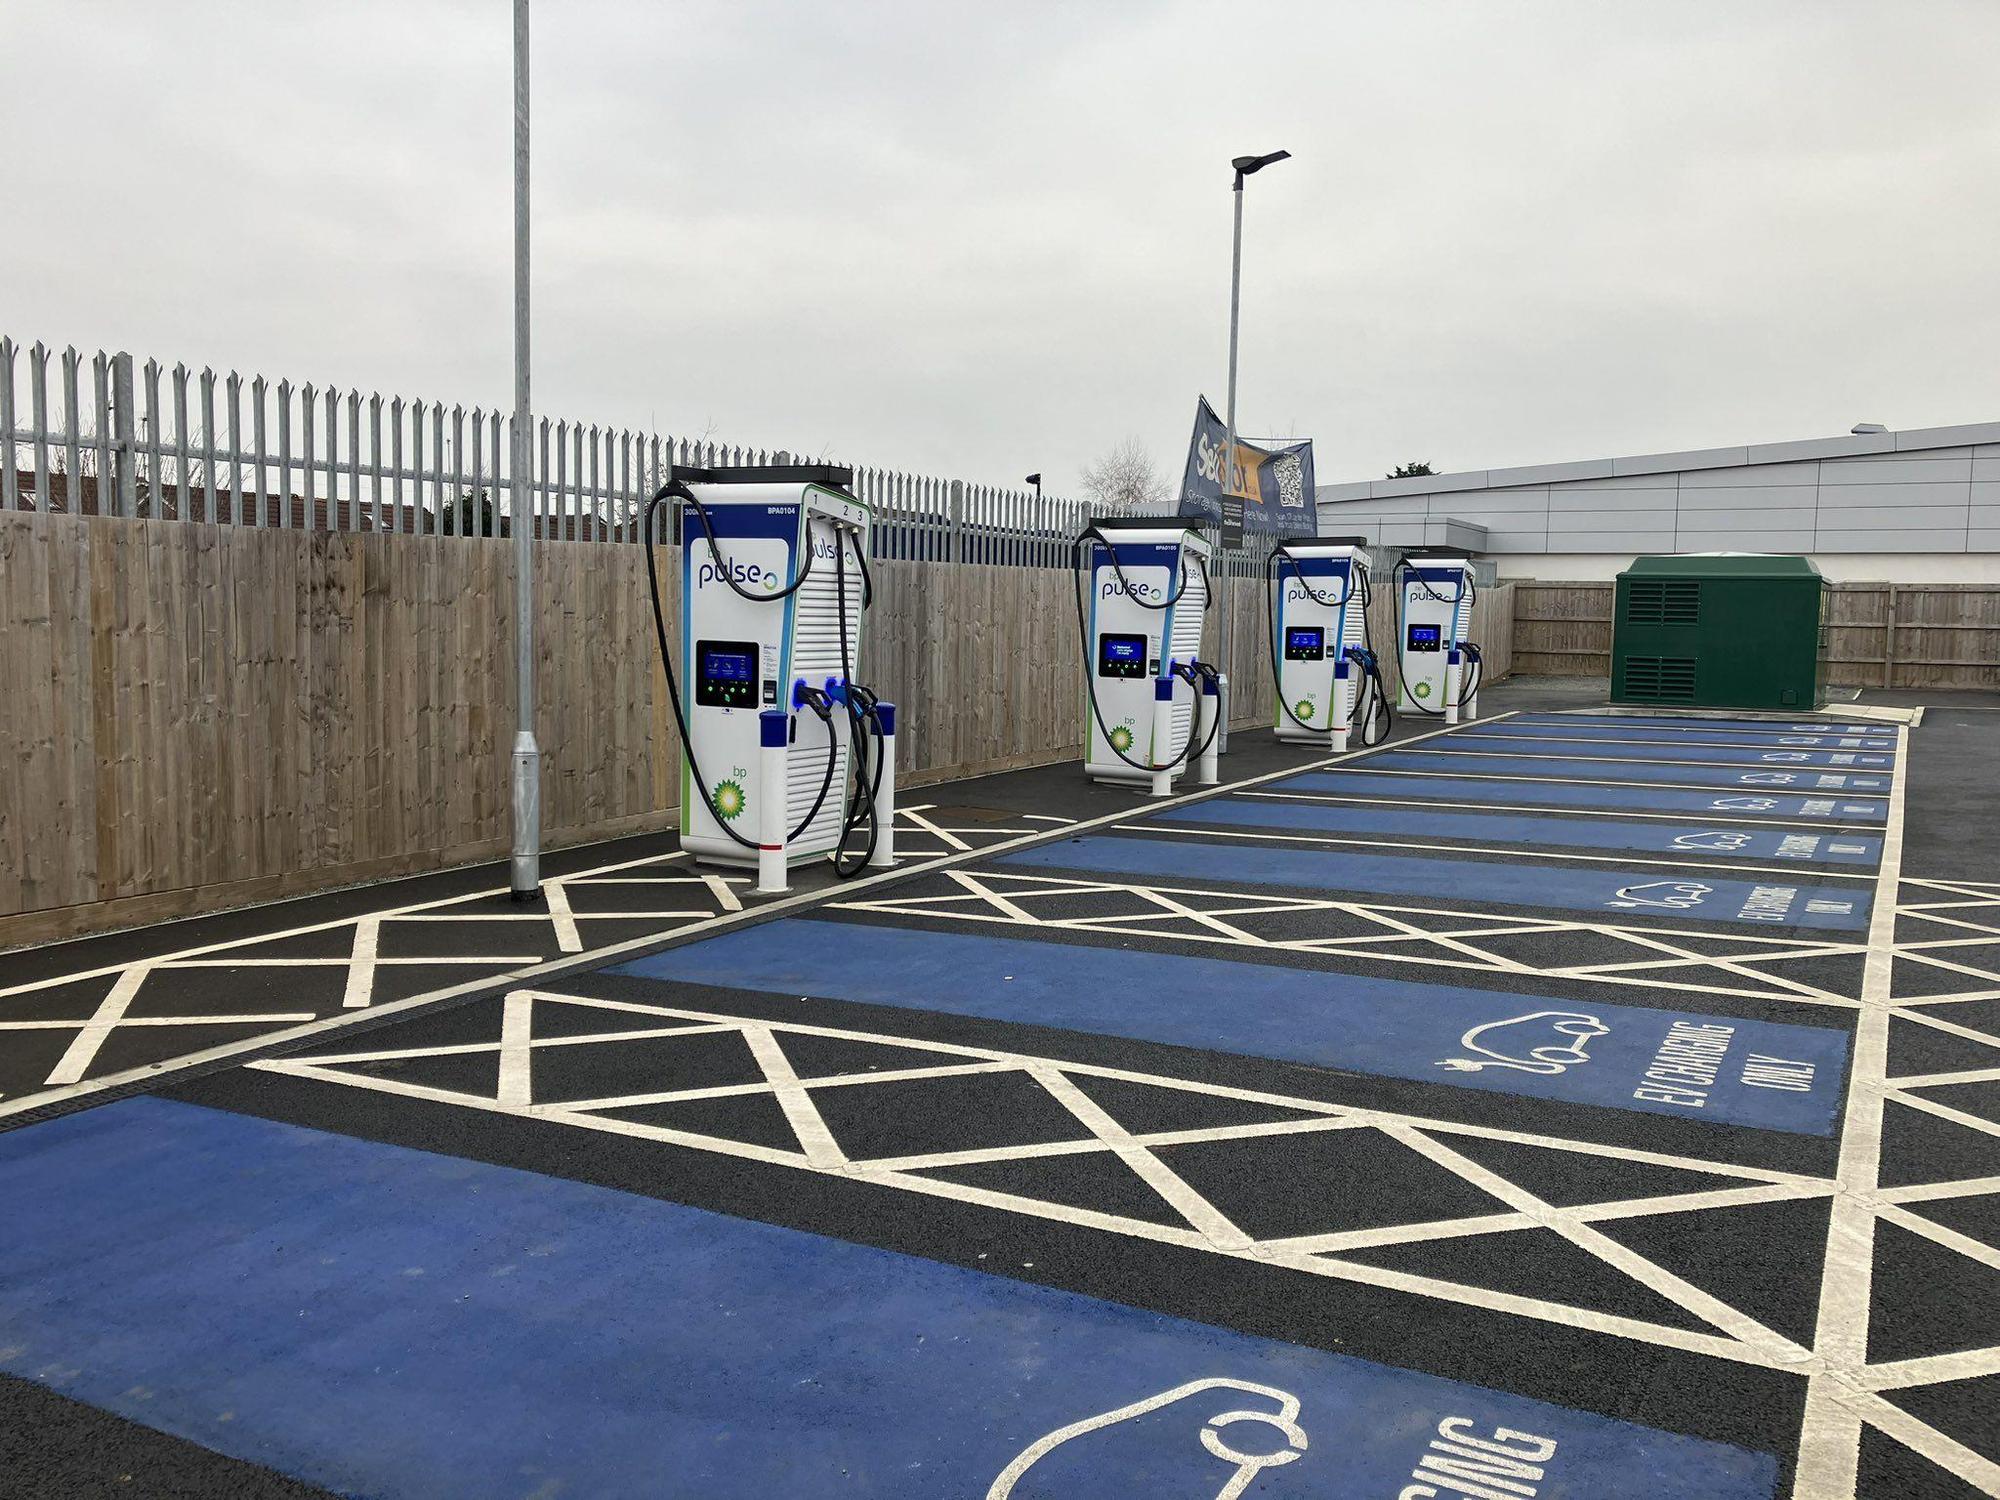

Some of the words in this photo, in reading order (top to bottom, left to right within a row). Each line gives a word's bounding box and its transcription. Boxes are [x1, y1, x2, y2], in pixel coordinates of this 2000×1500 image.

[767, 507, 796, 515] BPA0104
[813, 494, 818, 504] 1
[843, 506, 848, 516] 2
[857, 511, 863, 521] 3
[814, 537, 840, 560] uls
[699, 557, 761, 589] pulse
[1102, 578, 1150, 600] pulse
[1288, 586, 1327, 603] pulse
[1124, 717, 1136, 726] bp
[733, 765, 747, 779] bp
[1645, 1021, 1736, 1086] CHARGING
[1740, 1053, 1816, 1092] ONLY
[1633, 1080, 1708, 1108] EV
